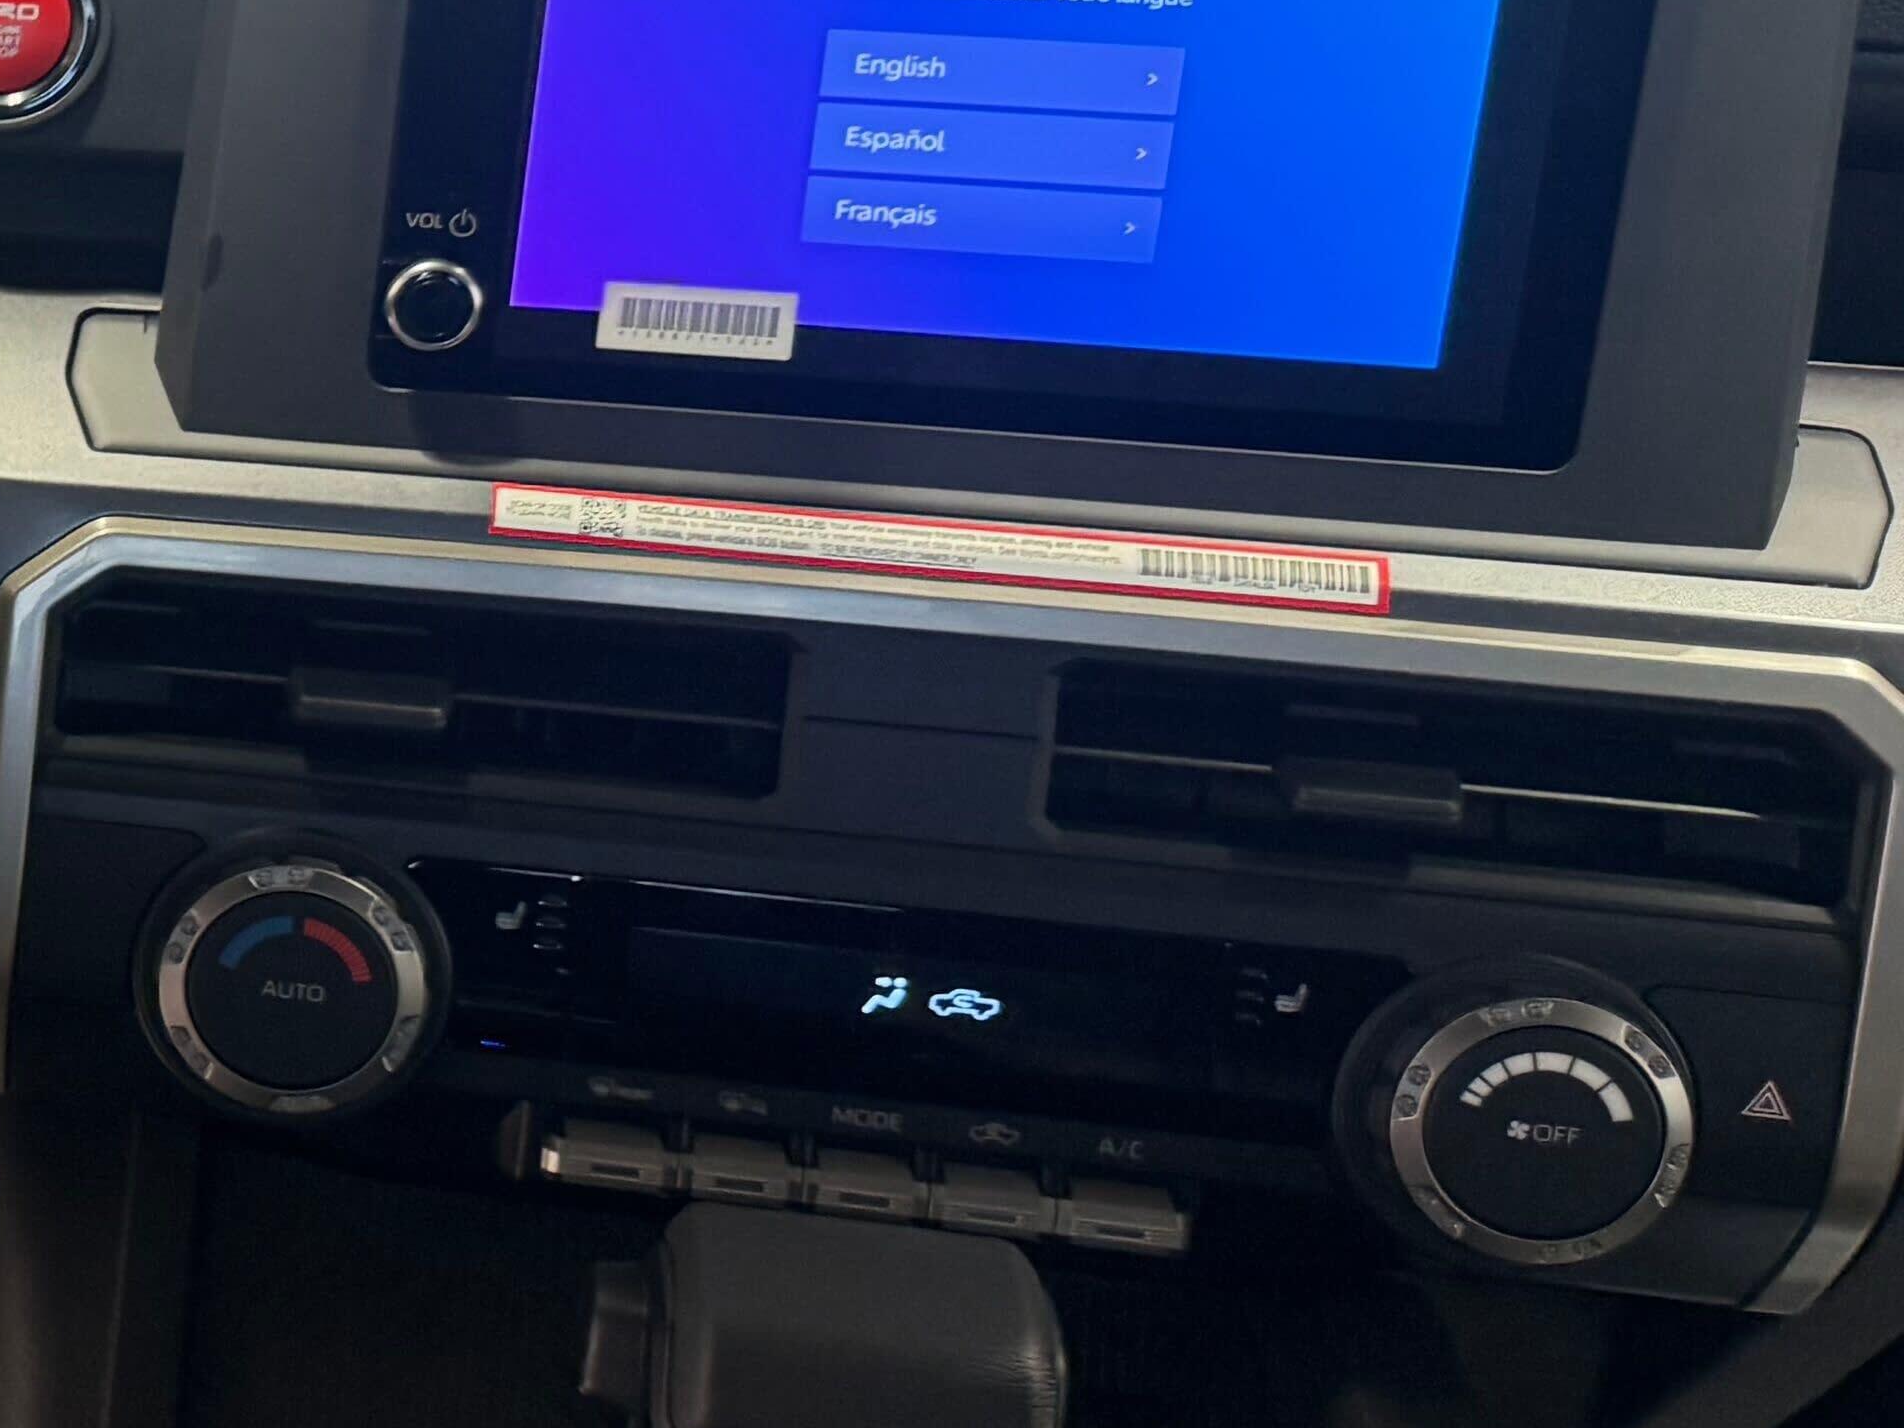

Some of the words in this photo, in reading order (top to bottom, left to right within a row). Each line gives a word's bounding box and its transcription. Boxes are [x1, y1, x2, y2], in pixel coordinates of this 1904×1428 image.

[853, 53, 946, 82] English
[844, 125, 945, 154] Español
[405, 212, 443, 229] VOL
[834, 198, 937, 229] Français
[261, 979, 326, 1003] AUTO
[831, 1105, 904, 1133] MODE
[1532, 1123, 1583, 1146] OFF
[1098, 1137, 1143, 1160] A/C
